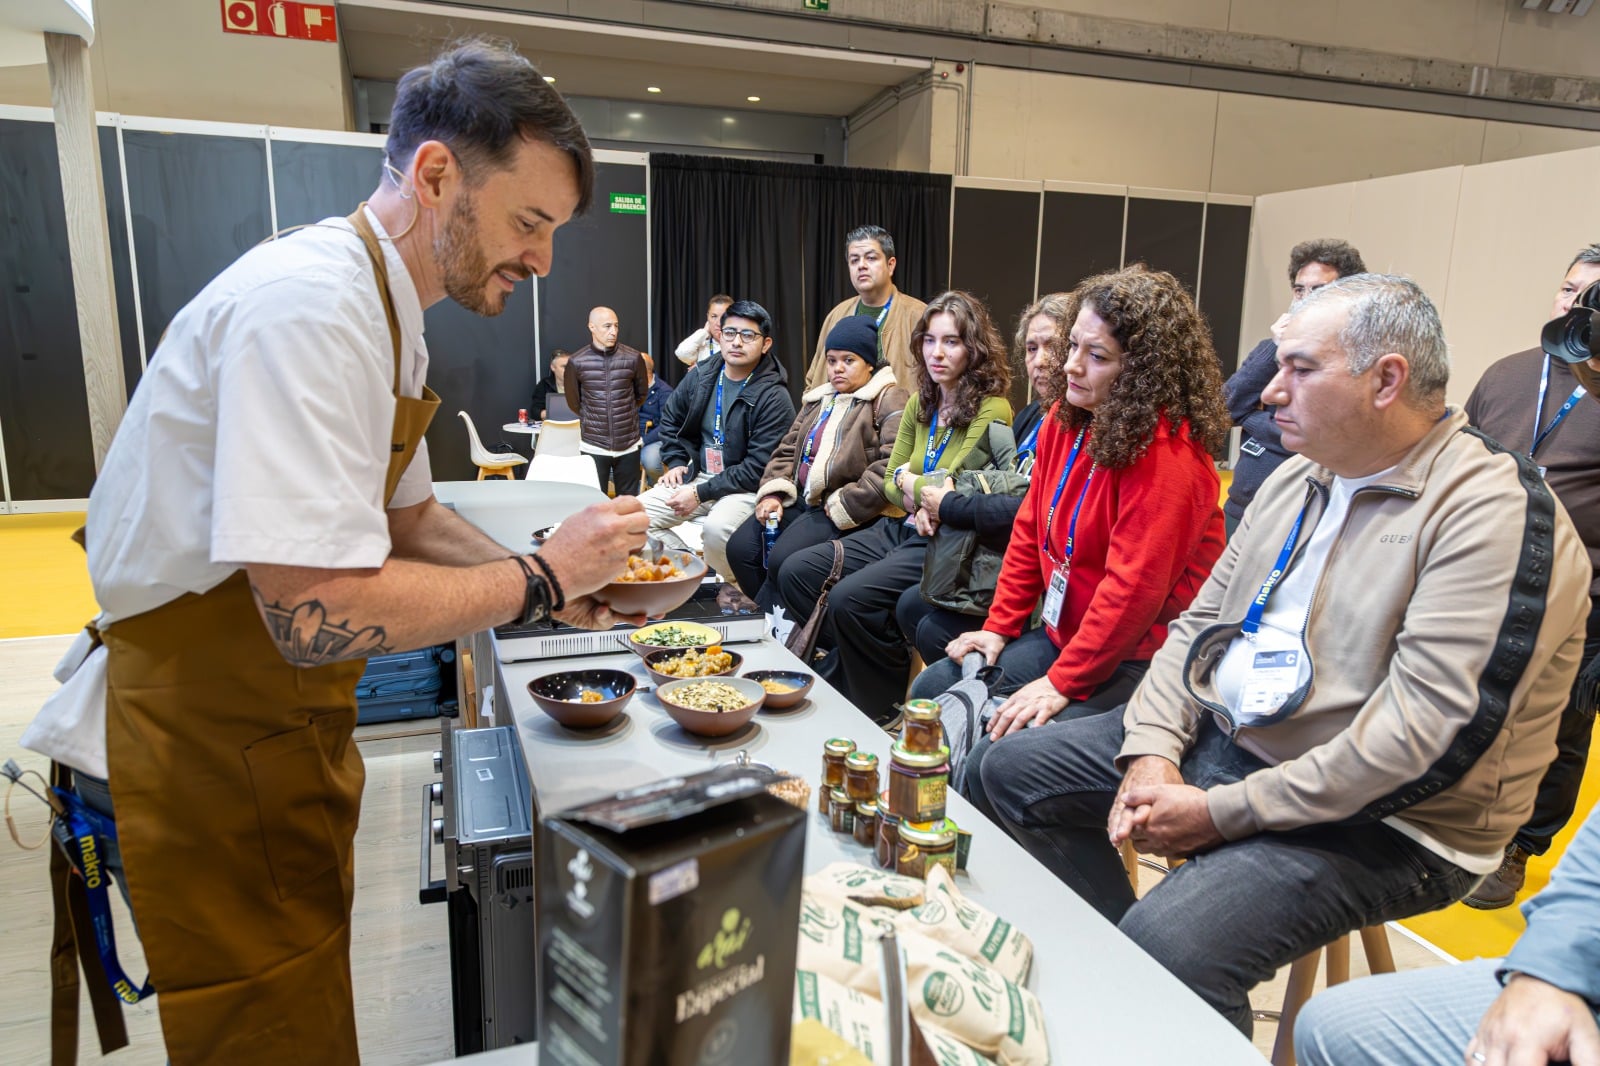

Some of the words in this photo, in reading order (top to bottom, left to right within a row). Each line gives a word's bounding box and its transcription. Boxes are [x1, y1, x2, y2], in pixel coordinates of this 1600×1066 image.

[615, 196, 634, 204] SALIDA
[611, 202, 646, 210] EMERGENCIA
[1379, 534, 1414, 545] GUE
[1255, 568, 1281, 605] makro
[79, 834, 102, 889] makro
